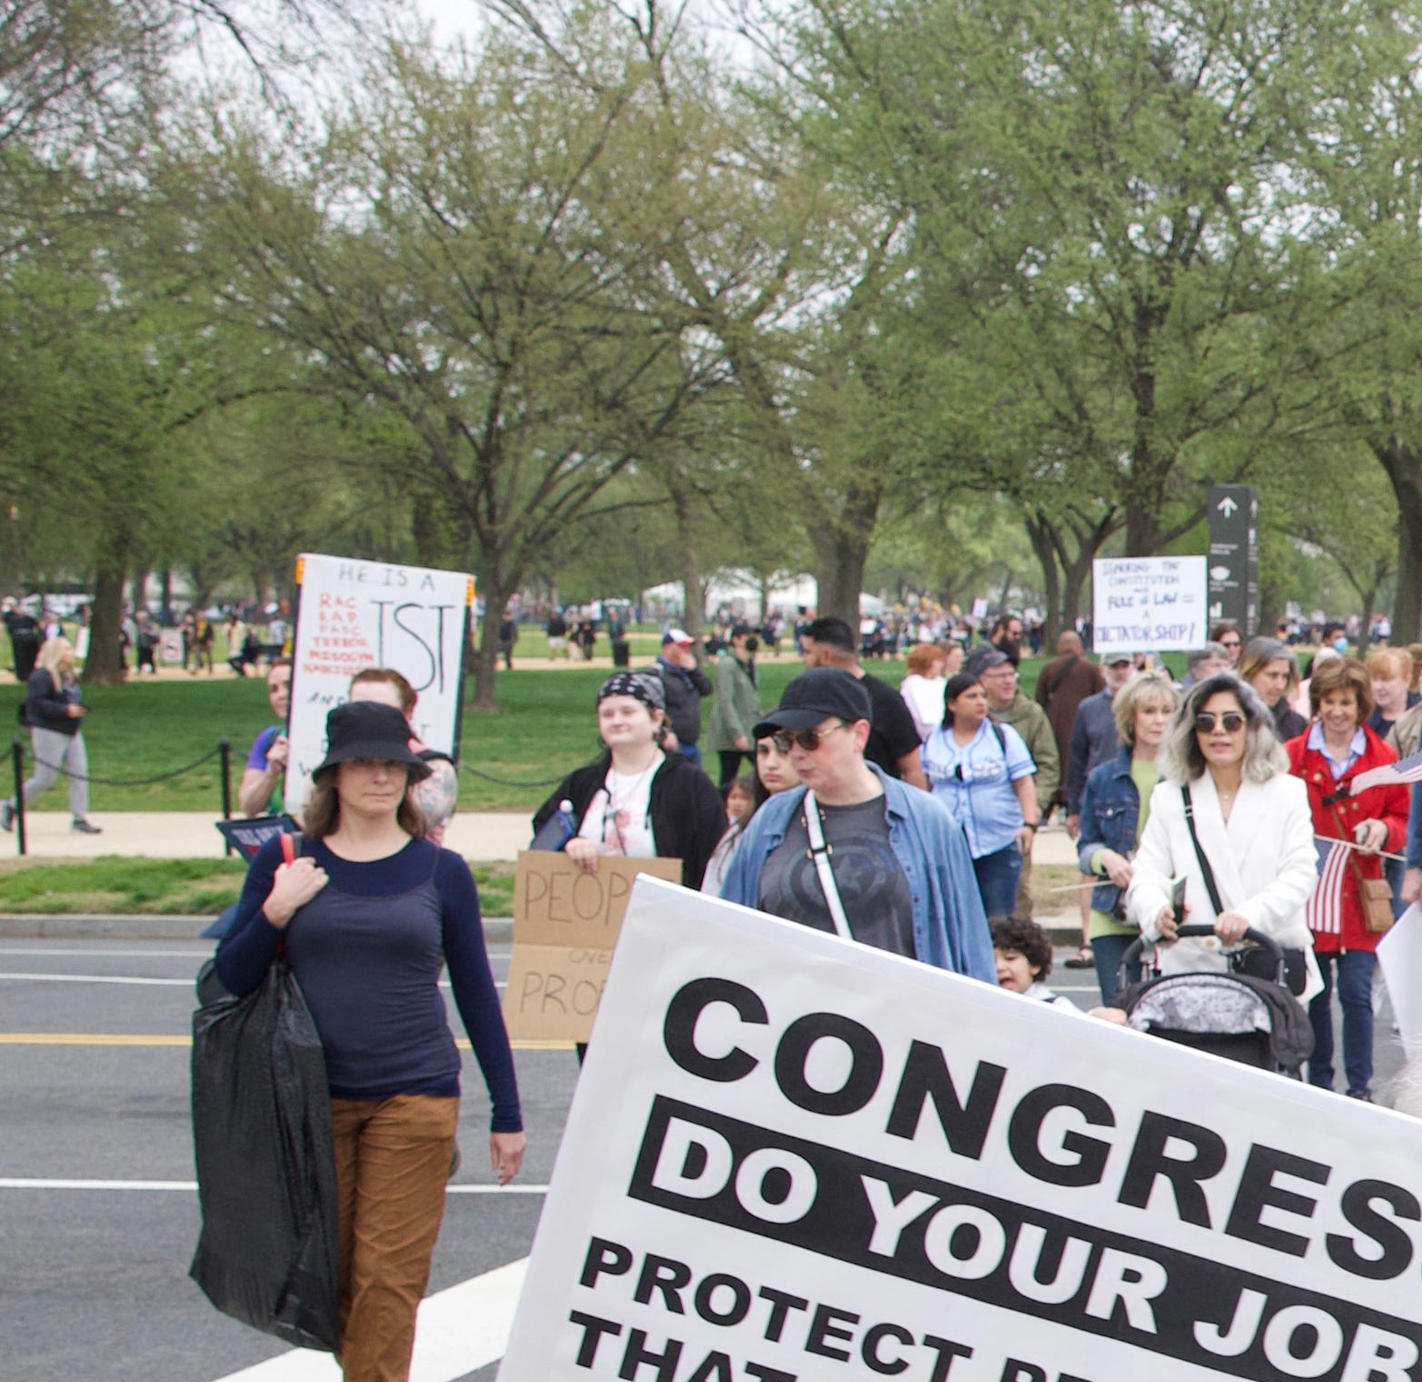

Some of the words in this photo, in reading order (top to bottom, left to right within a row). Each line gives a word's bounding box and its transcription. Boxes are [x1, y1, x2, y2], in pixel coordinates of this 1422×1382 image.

[338, 564, 369, 583] HE
[383, 568, 408, 586] IS
[420, 574, 436, 591] A
[371, 601, 456, 694] IST
[525, 870, 629, 926] PEOP
[568, 949, 609, 964] OVE
[520, 971, 605, 1016] PRO
[649, 1116, 820, 1225] DO
[862, 1176, 1169, 1334] YOUR
